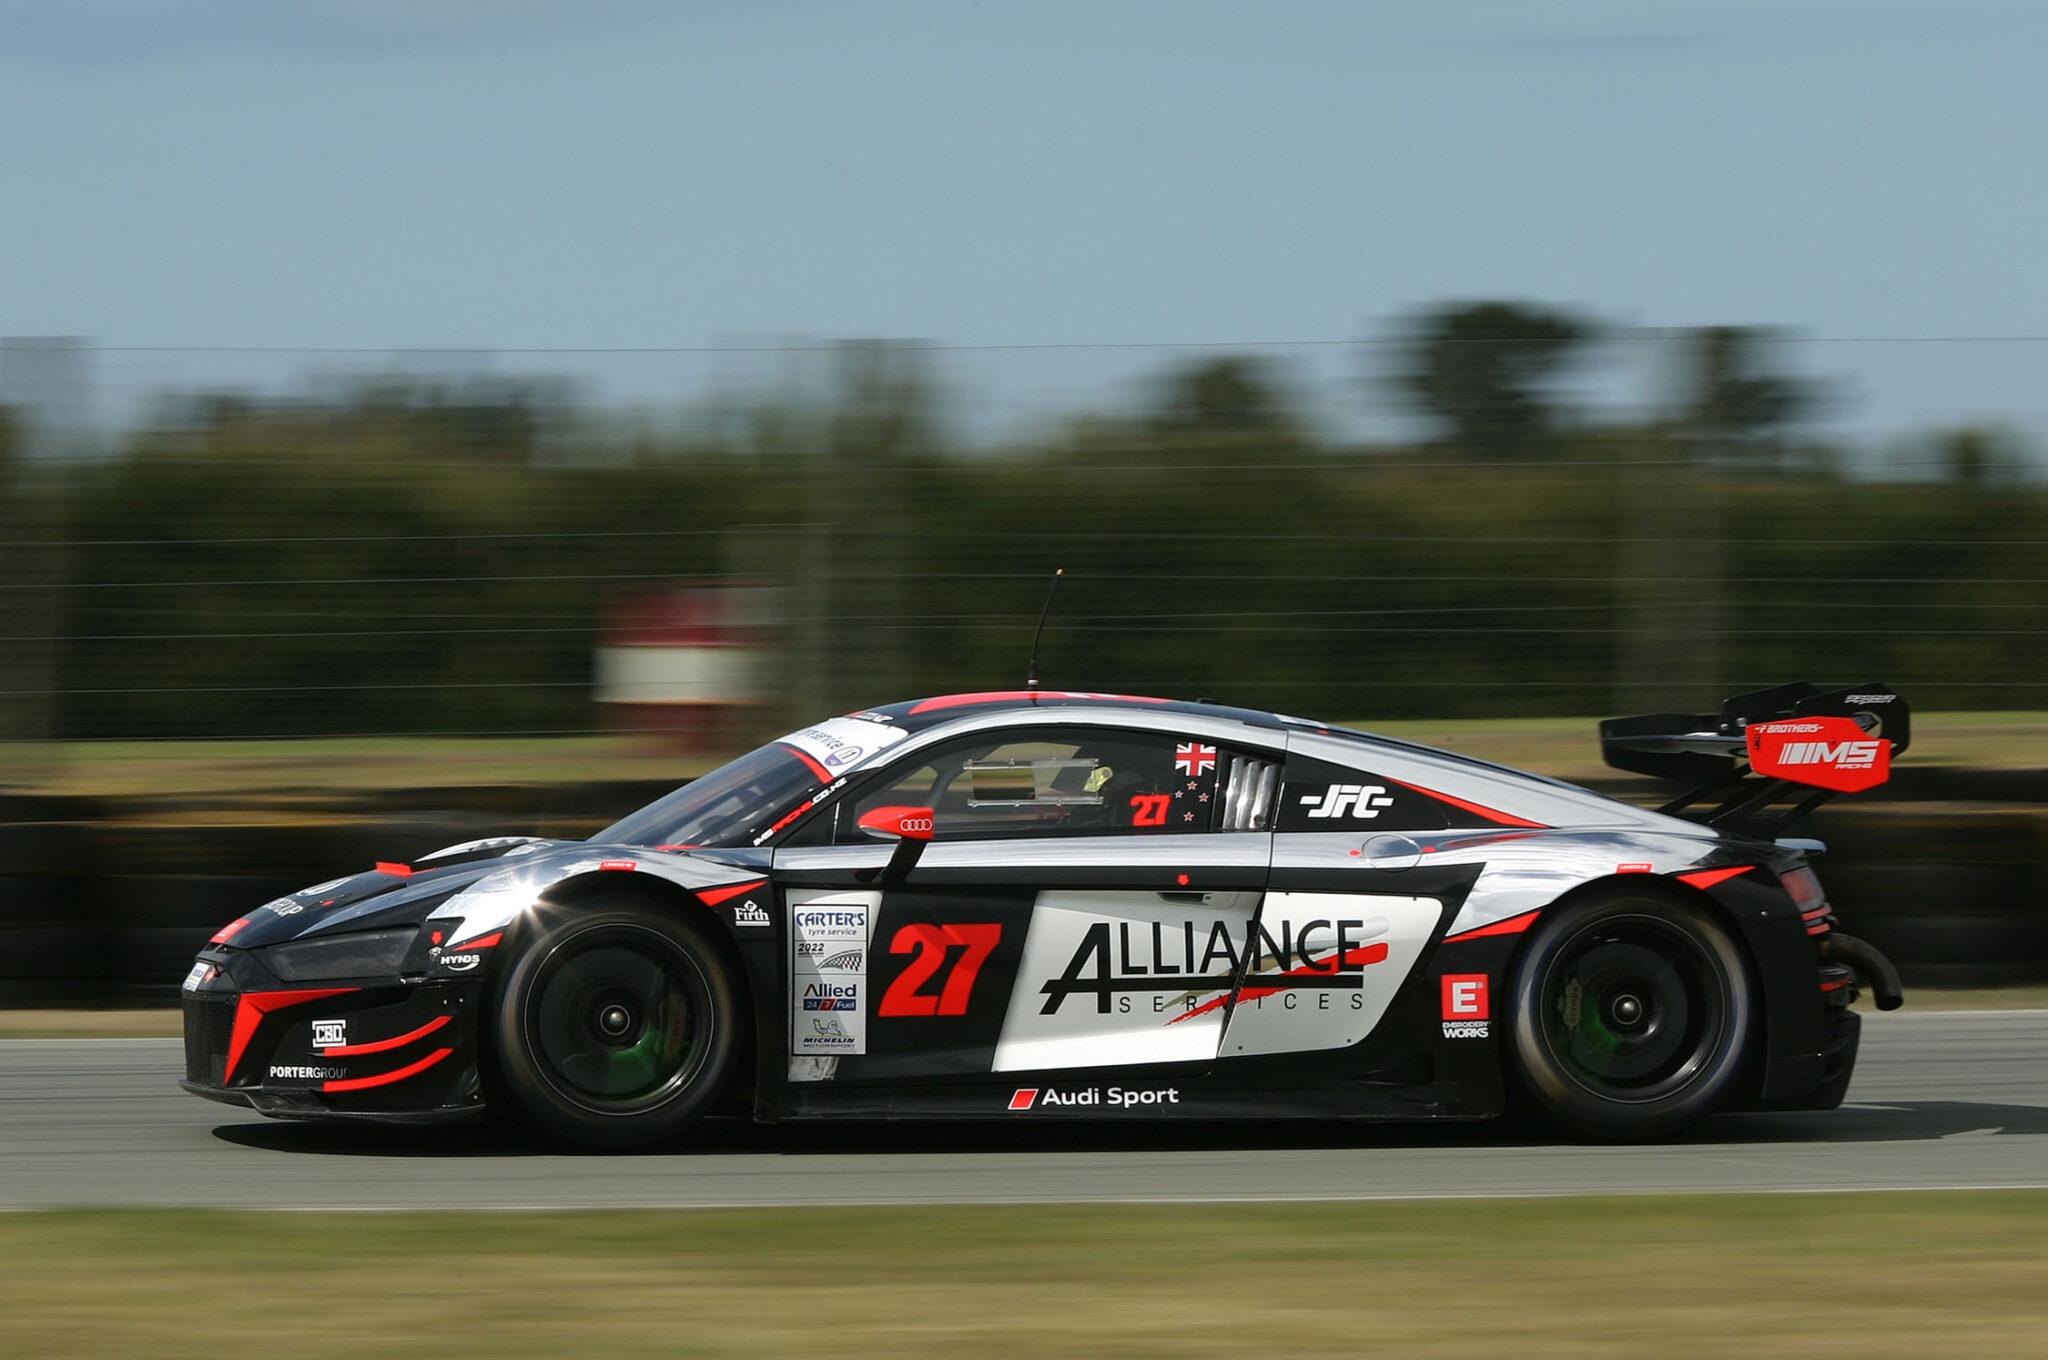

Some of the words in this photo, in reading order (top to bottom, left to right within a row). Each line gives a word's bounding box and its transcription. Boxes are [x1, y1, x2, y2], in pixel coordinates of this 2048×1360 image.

[1129, 794, 1170, 826] 27
[734, 907, 769, 920] Firth
[808, 928, 826, 936] tyre
[798, 943, 825, 952] 2022
[440, 954, 480, 965] HYNDS
[879, 923, 1002, 1016] 27
[1039, 920, 1364, 1015] ALLIANCE
[804, 983, 857, 997] Allied
[315, 1025, 343, 1043] CBD
[1443, 1028, 1489, 1038] WORKS
[1041, 1088, 1100, 1106] Audi
[1106, 1087, 1179, 1108] Sport
